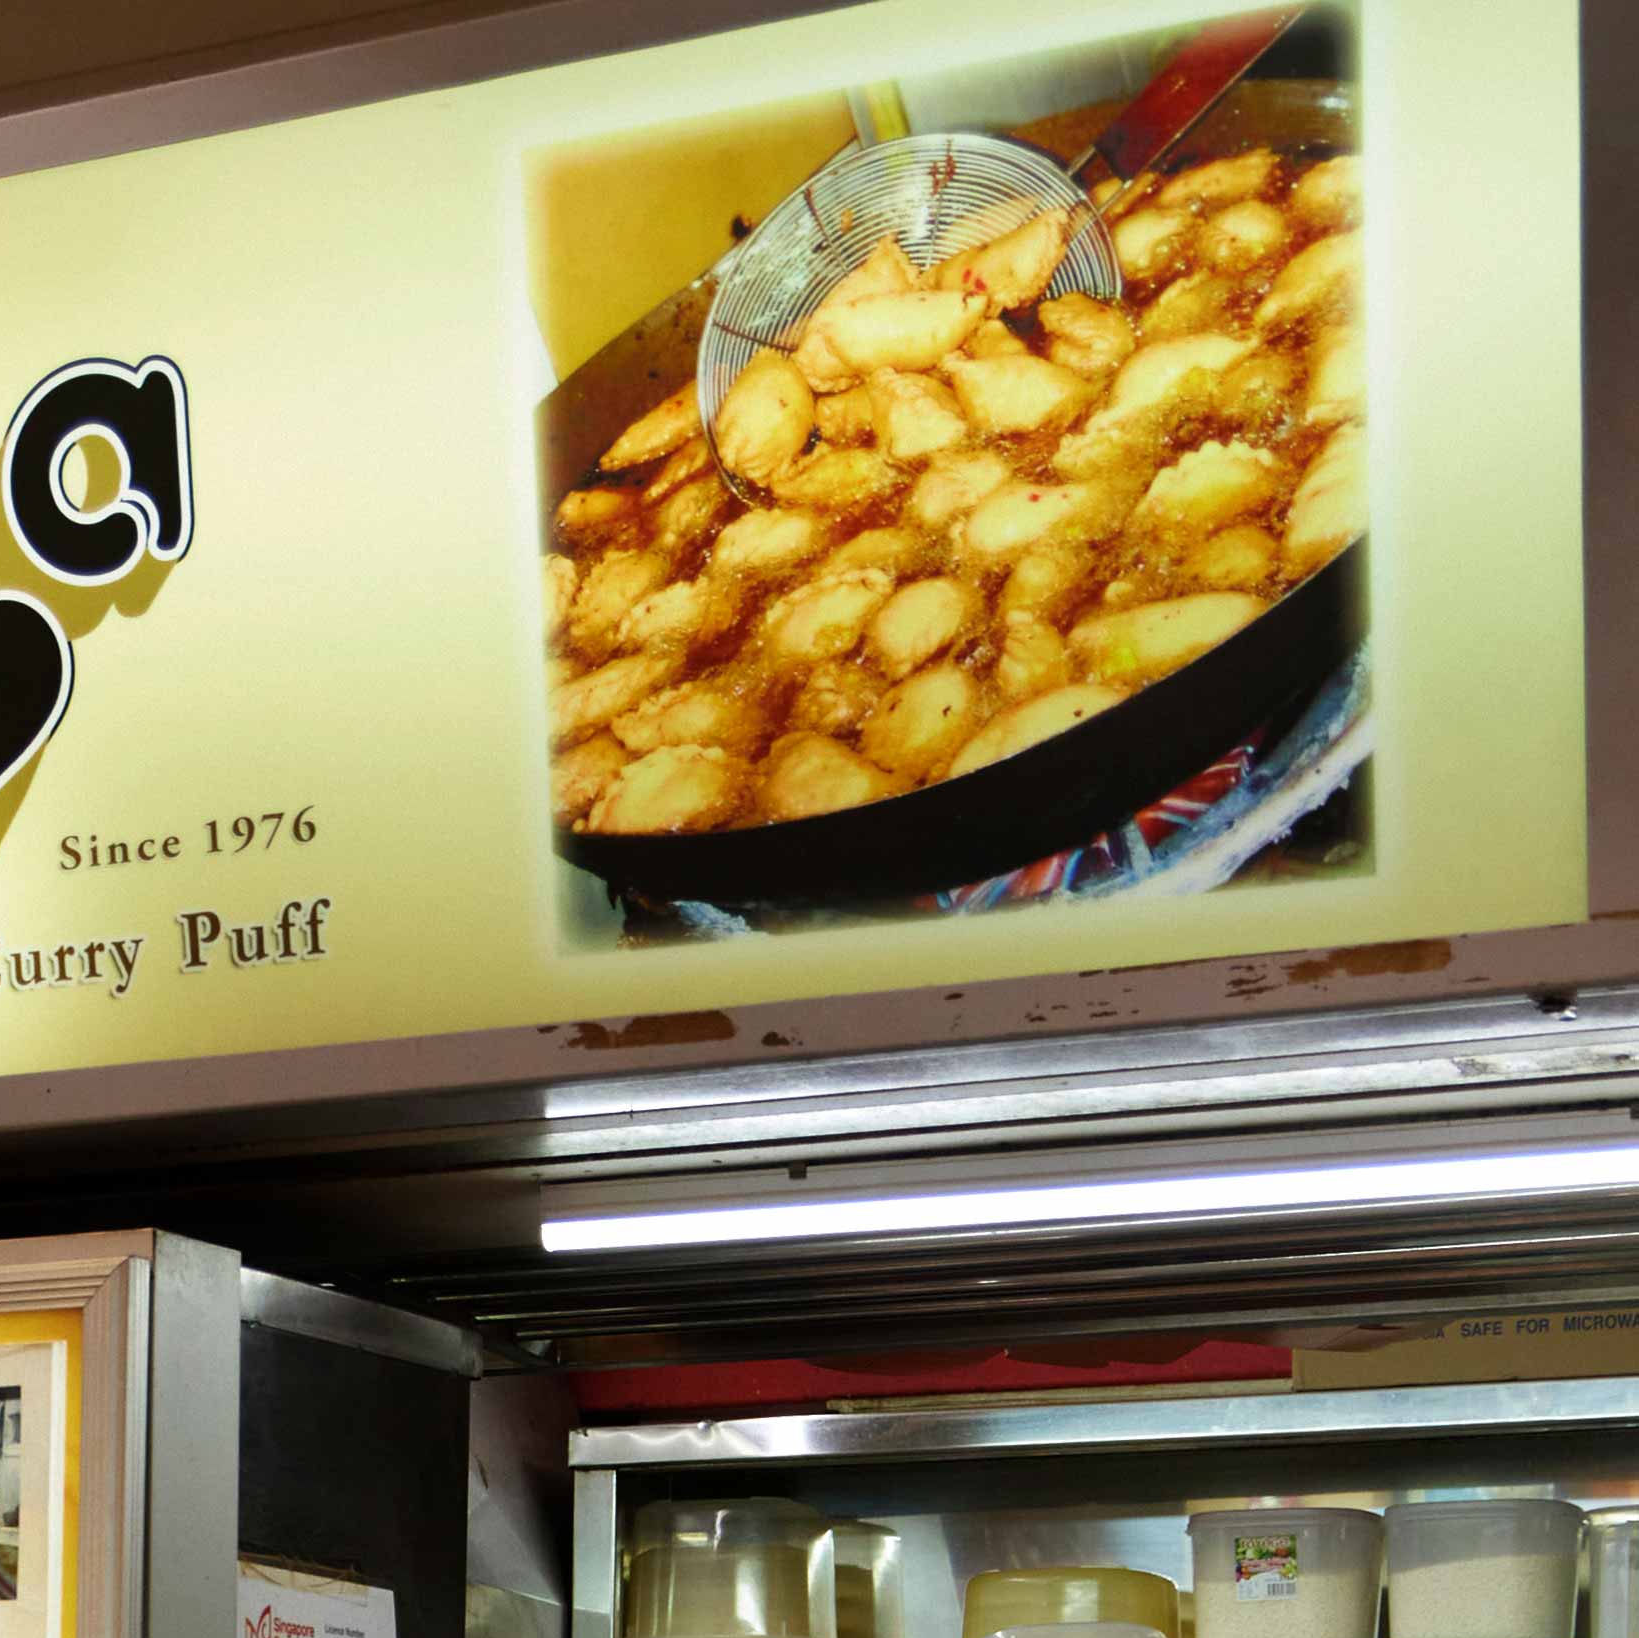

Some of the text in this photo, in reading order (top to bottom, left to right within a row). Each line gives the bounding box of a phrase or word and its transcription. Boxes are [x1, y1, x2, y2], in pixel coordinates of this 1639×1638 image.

[59, 806, 318, 872] Since 1976
[180, 898, 331, 972] Puff
[1460, 1321, 1503, 1337] SAFE
[1516, 1318, 1550, 1334] FOR
[273, 1617, 315, 1638] Singapore
